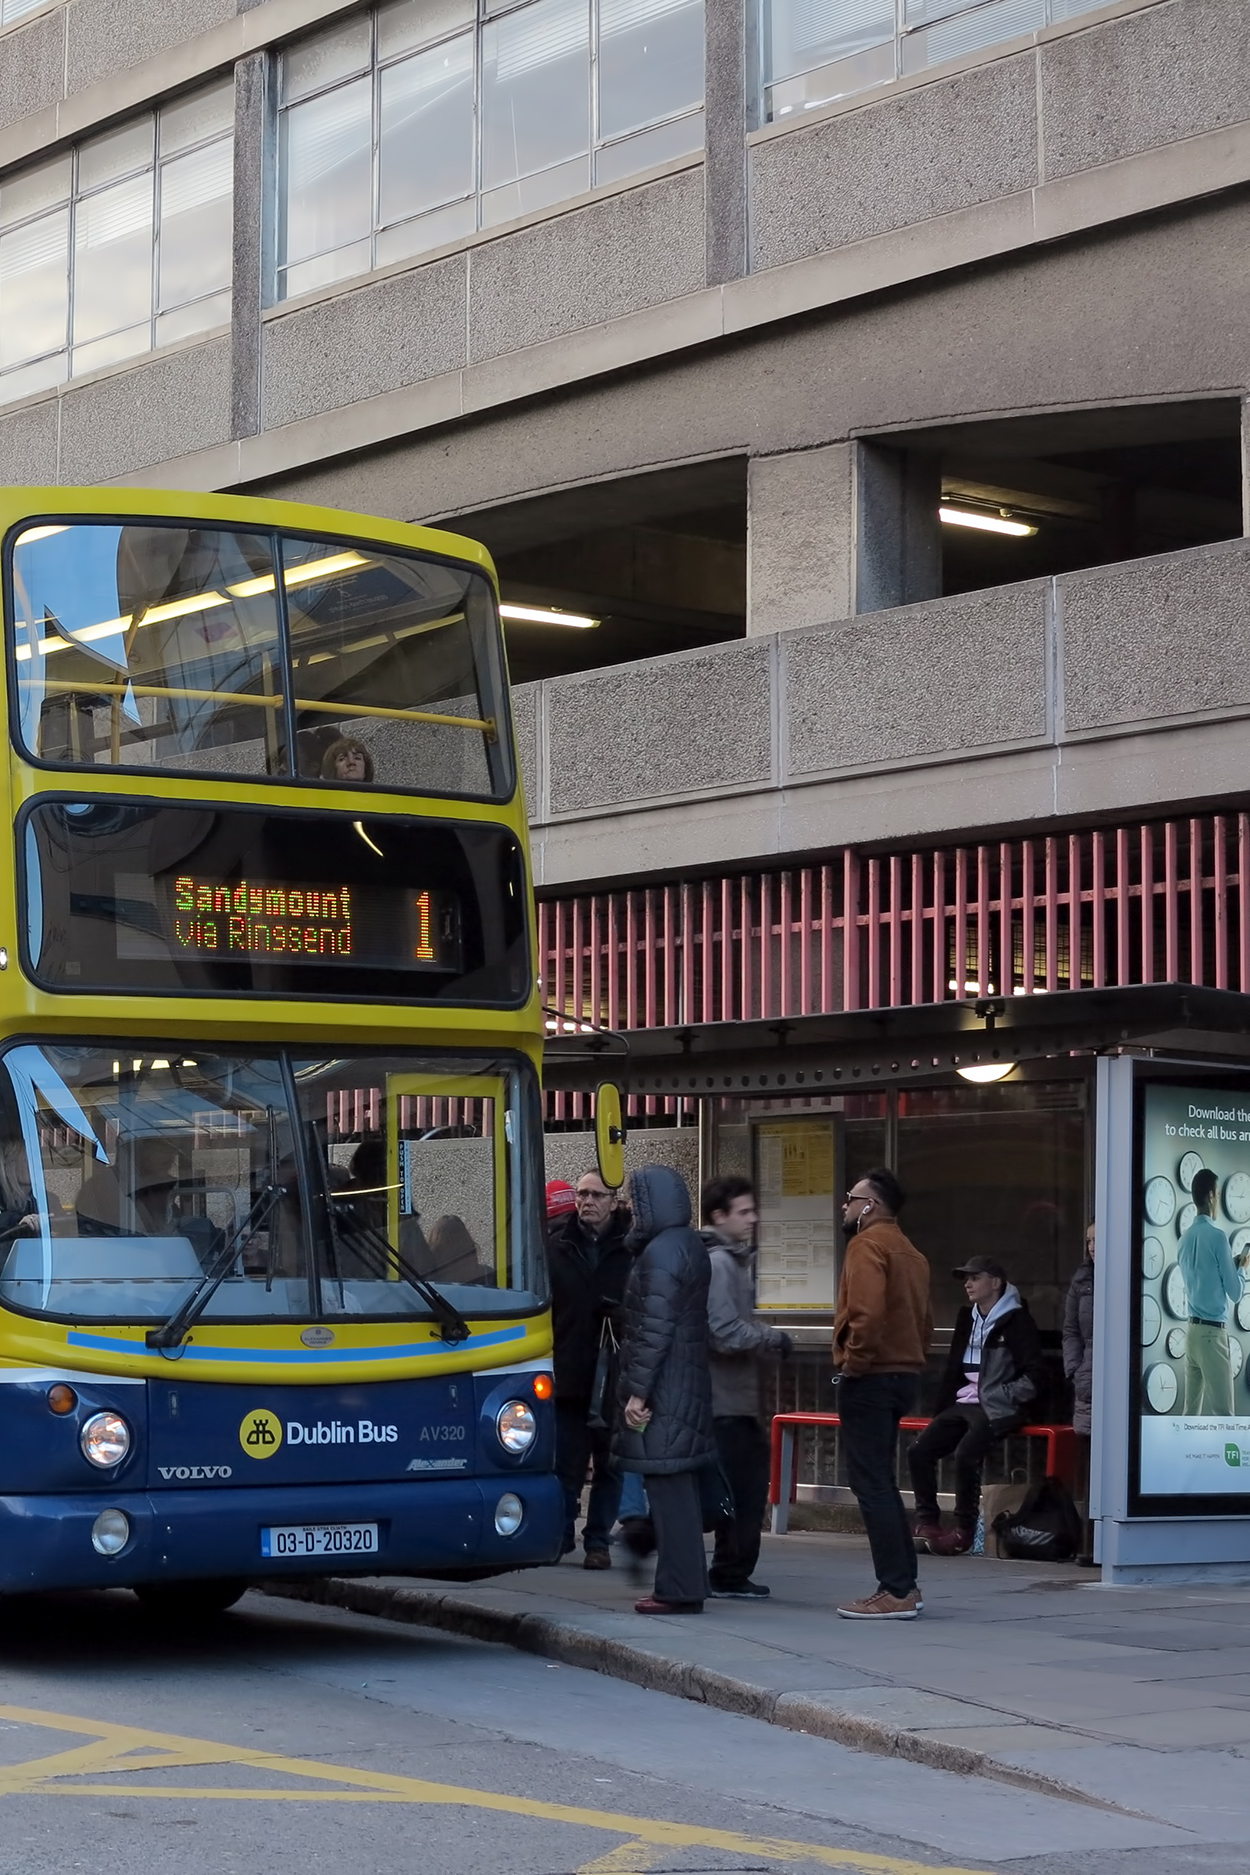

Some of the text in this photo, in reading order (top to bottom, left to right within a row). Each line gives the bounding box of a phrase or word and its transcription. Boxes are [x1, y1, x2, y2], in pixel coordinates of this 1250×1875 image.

[175, 877, 351, 919] Sandymount
[416, 891, 434, 958] 1
[175, 915, 351, 954] via Ringsend
[1188, 1104, 1235, 1121] Download
[1165, 1123, 1176, 1136] to
[1178, 1123, 1206, 1138] check
[1207, 1125, 1219, 1139] all
[1220, 1126, 1237, 1140] bus
[286, 1420, 398, 1444] Dublin Bus
[419, 1425, 465, 1441] AV320
[1226, 1450, 1239, 1459] TFI
[157, 1465, 232, 1480] VOLVO
[405, 1458, 467, 1471] Alexander
[277, 1530, 372, 1553] 03-D-20320
